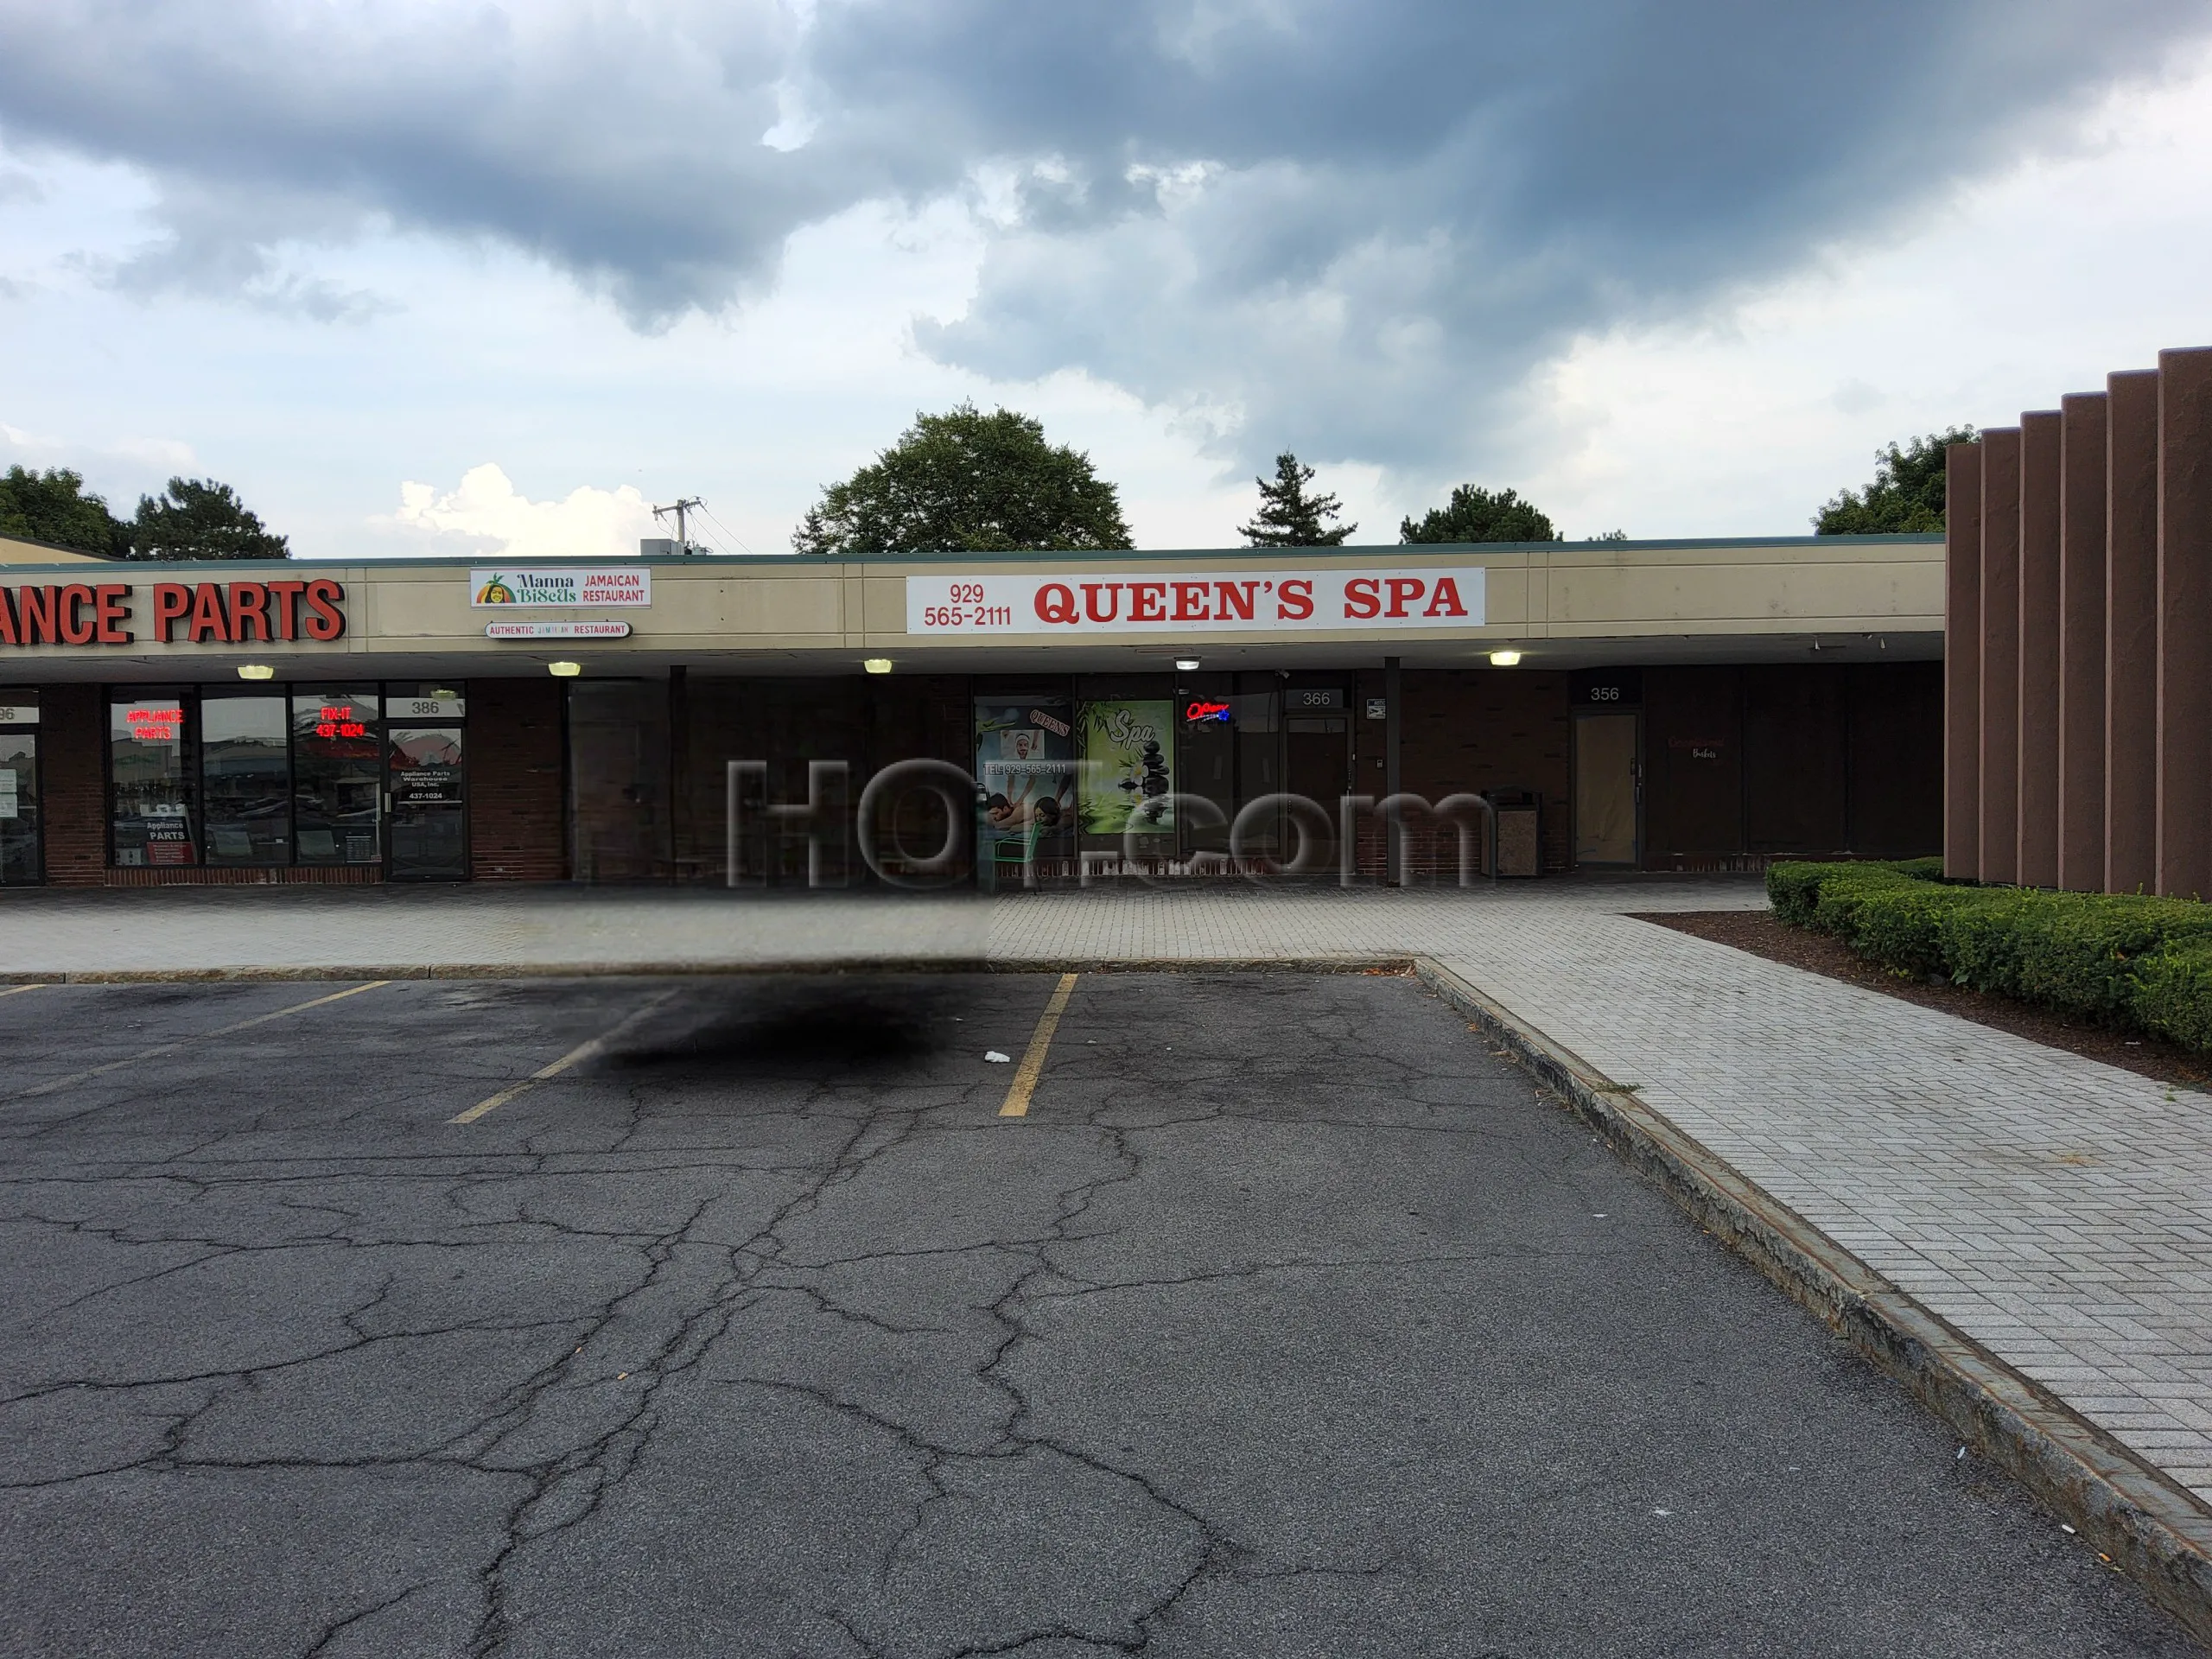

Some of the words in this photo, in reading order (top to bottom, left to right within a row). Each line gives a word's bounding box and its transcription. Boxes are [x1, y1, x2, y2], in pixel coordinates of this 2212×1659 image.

[517, 574, 574, 588] Manna
[585, 575, 639, 587] JAMAICAN
[582, 590, 645, 602] RESTAURANT
[949, 583, 984, 604] 929
[1033, 580, 1313, 624] QUEEN'S
[1344, 577, 1468, 620] SPA
[154, 579, 346, 643] PARTS
[924, 607, 1011, 626] 565-2111
[490, 626, 534, 635] AUTHENTIC
[574, 625, 626, 634] RESTAURANT
[1303, 692, 1330, 705] 366
[1591, 688, 1619, 701] 356
[321, 707, 352, 720] FIX-IT
[411, 701, 440, 714] 386
[127, 709, 184, 723] APPLIANCE
[1031, 709, 1070, 736] QUEENS
[135, 727, 171, 740] PARTS
[316, 724, 364, 737] 437-1024
[1109, 709, 1155, 750] Spa
[983, 763, 1004, 775] TEL:
[1004, 763, 1066, 775] 929-565-2111
[147, 821, 183, 831] Appliance
[149, 831, 185, 841] PARTS
